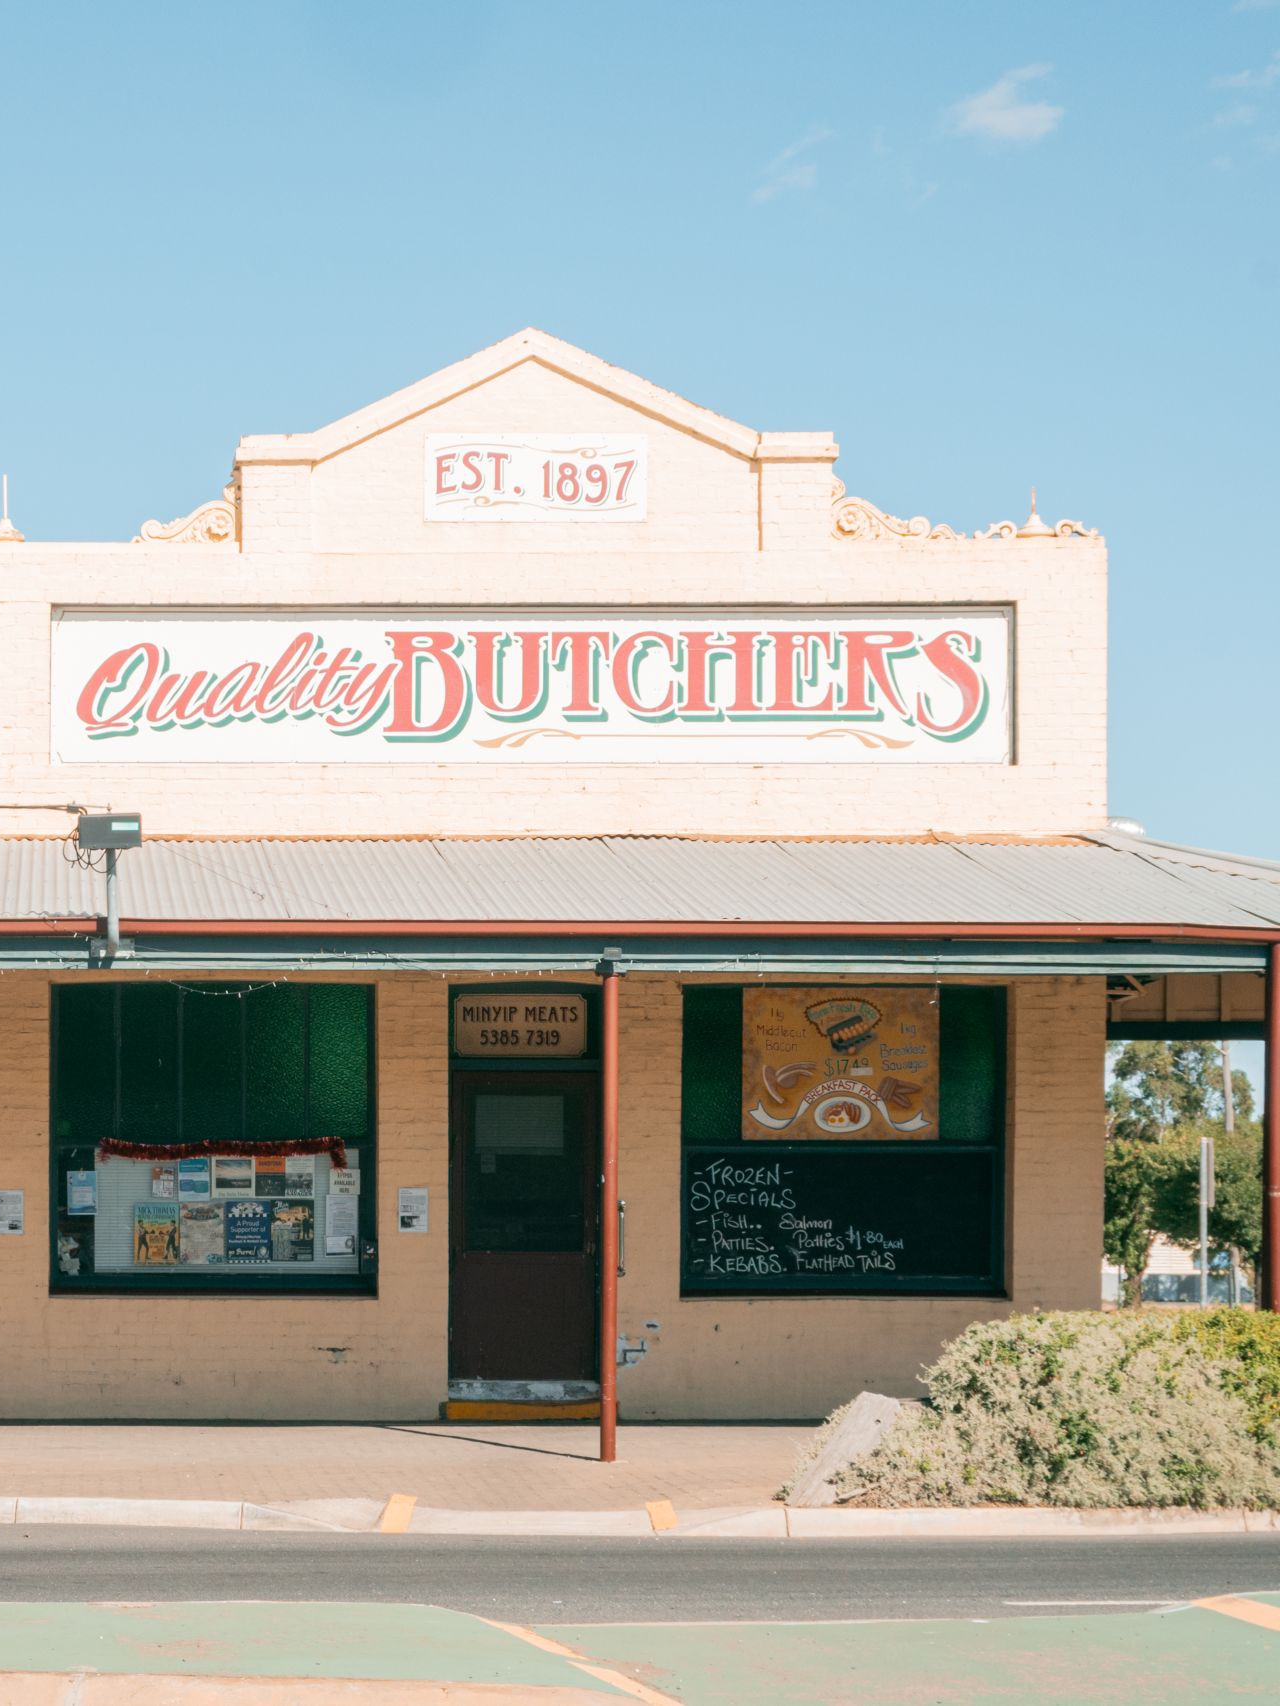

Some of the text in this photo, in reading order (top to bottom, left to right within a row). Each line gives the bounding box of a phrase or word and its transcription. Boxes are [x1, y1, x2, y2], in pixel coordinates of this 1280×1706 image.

[434, 452, 639, 506] EST. 1897
[76, 630, 989, 743] Quality BUTCHERS
[462, 1006, 578, 1022] MINYIP MEATS
[480, 1029, 560, 1046] 5385 7319
[805, 1080, 857, 1104] BREAKFAST
[230, 1226, 260, 1234] Supporter
[779, 1212, 832, 1230] Salmon
[792, 1230, 845, 1250] Patties
[883, 1239, 904, 1249] EACH
[793, 1250, 856, 1271] FLATHEAD
